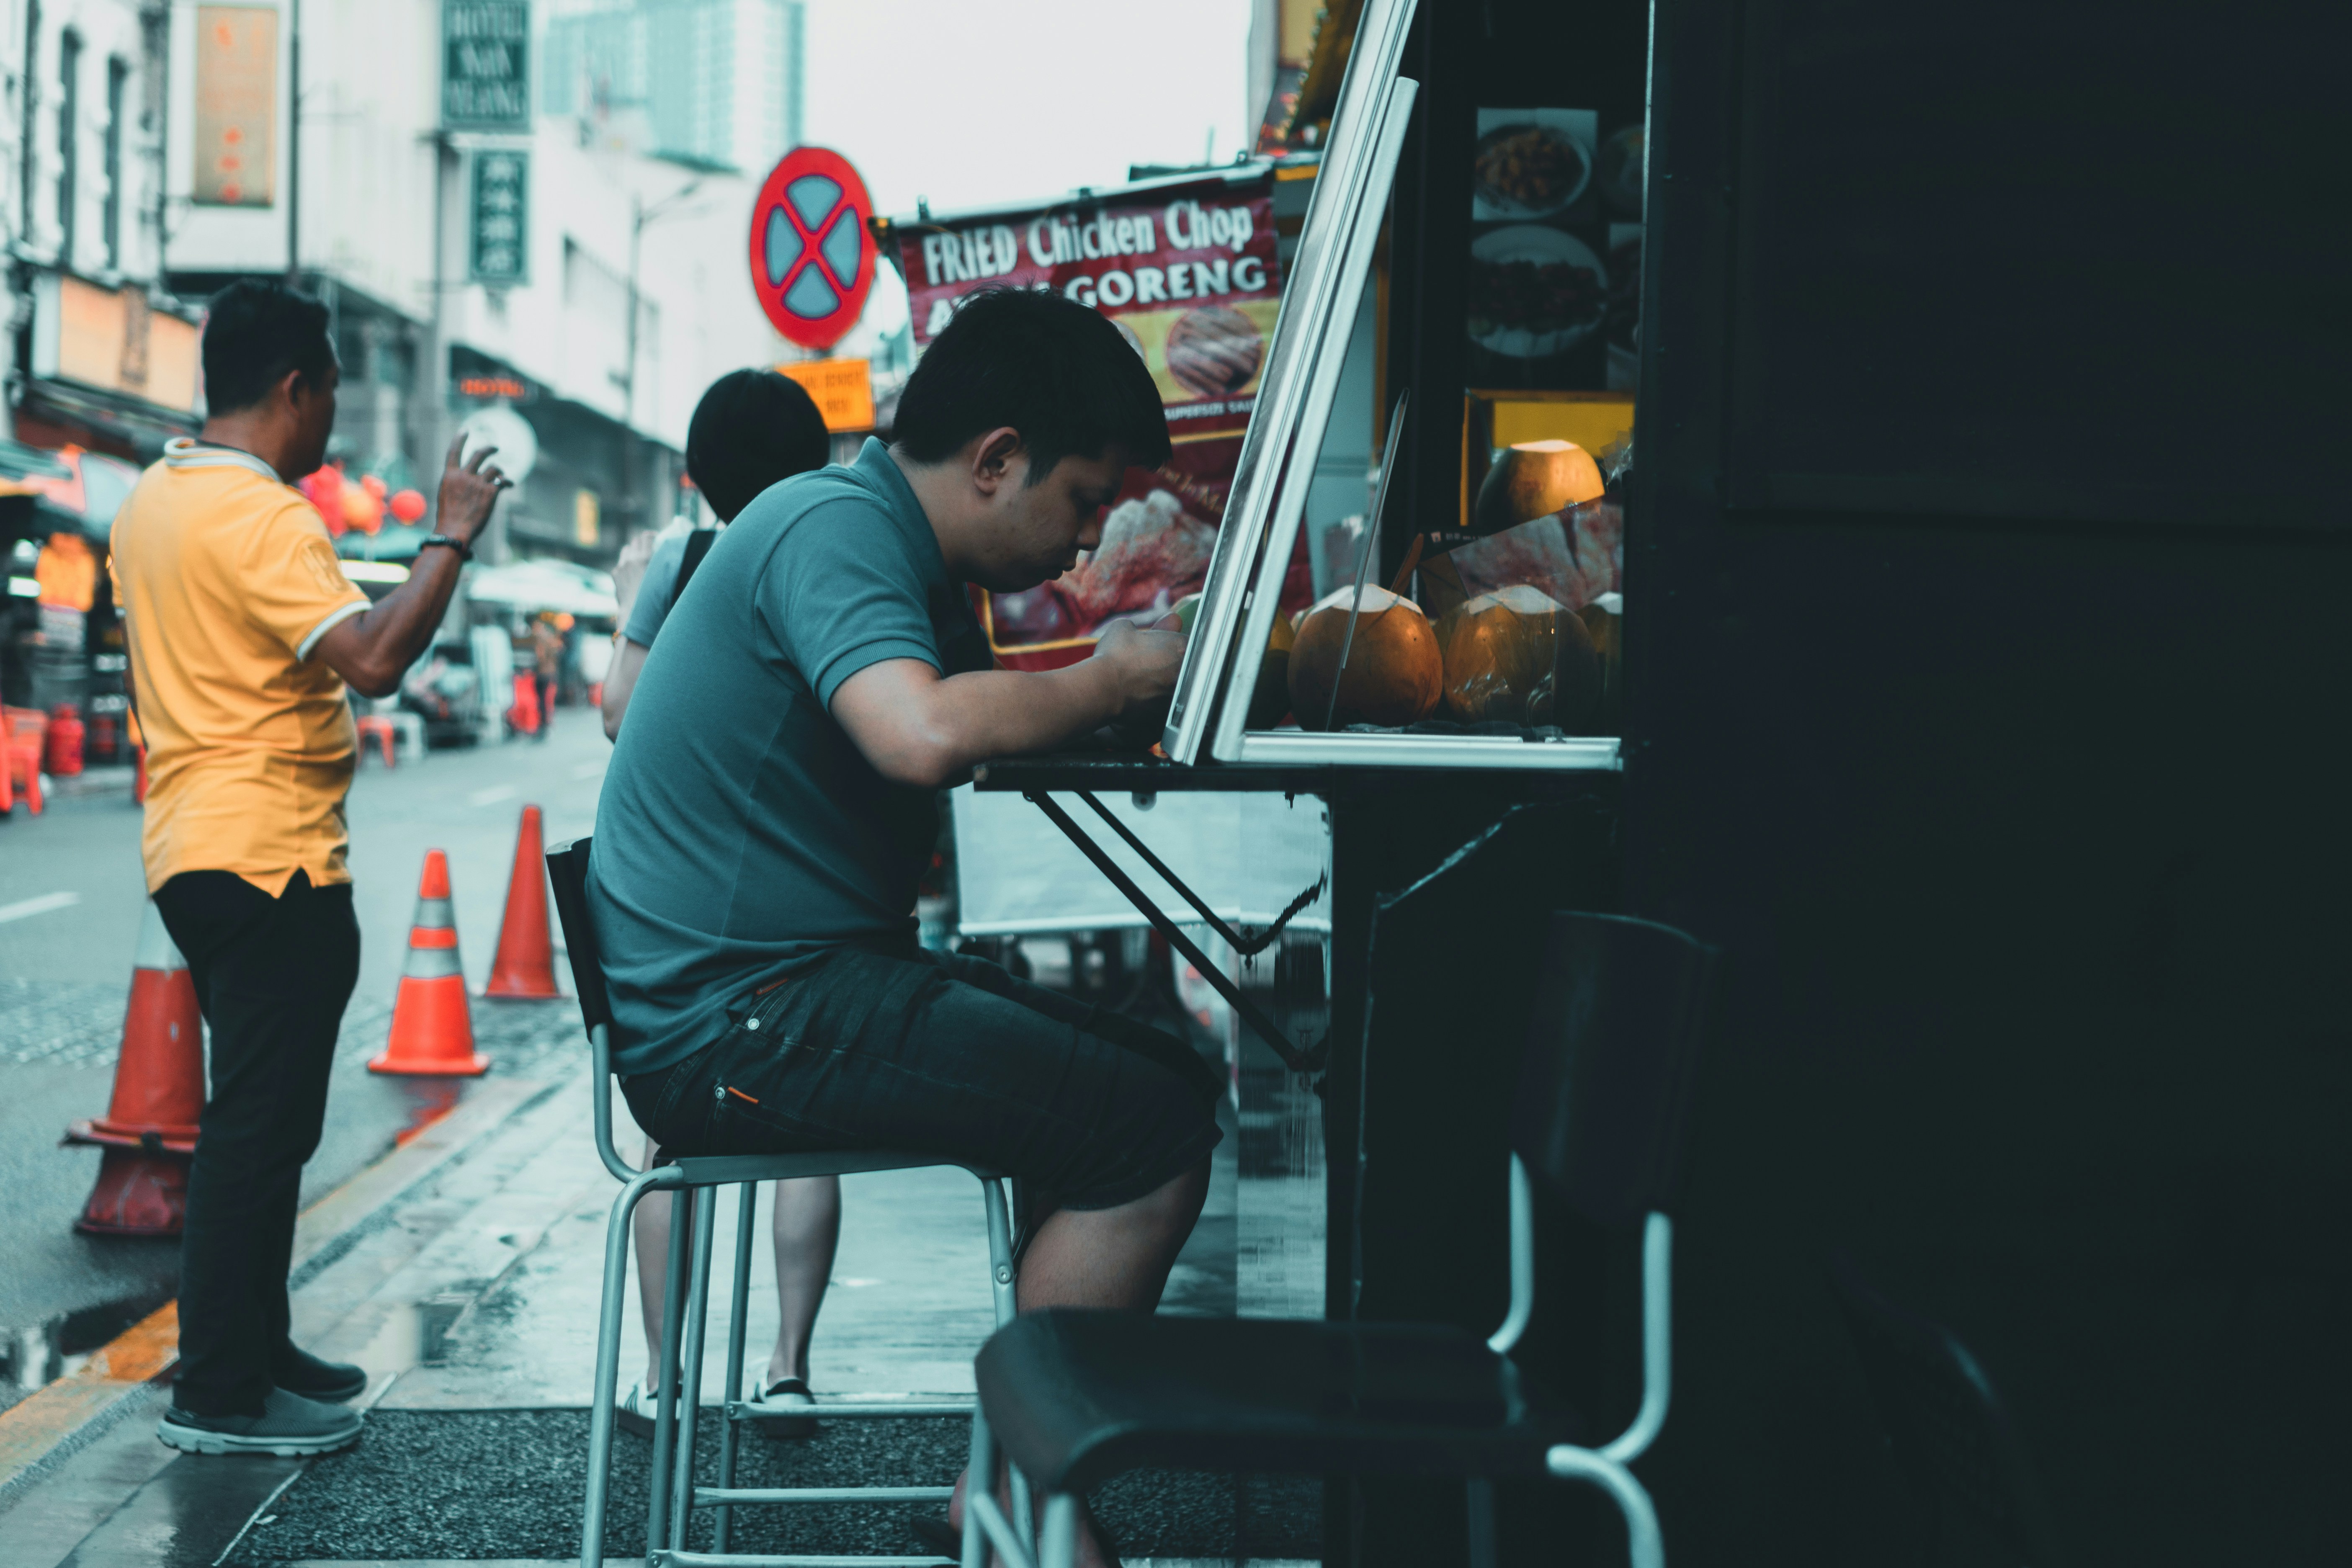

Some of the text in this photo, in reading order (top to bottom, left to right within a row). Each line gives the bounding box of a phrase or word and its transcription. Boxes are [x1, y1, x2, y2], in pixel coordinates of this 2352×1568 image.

[923, 198, 1254, 286] FRIED Chicken Chop
[1064, 255, 1266, 309] GORENG
